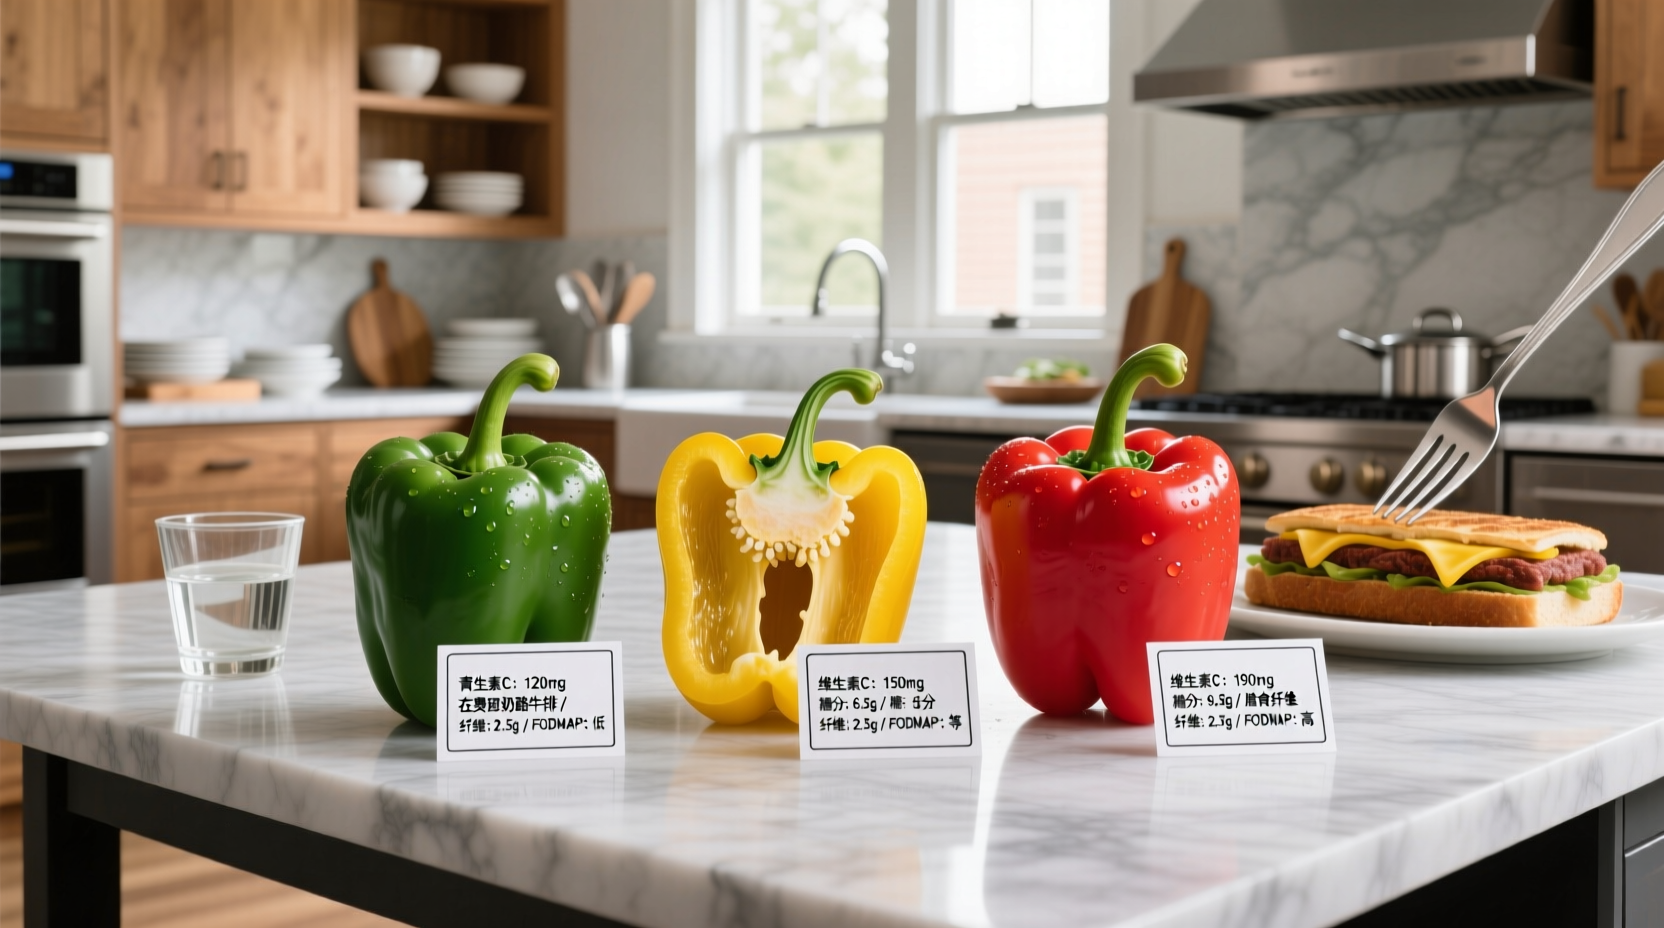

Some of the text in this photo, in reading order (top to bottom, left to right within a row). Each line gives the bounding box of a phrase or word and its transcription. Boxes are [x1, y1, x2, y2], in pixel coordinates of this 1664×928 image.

[883, 676, 925, 693] 150mg
[852, 697, 877, 713] 6.5g
[880, 696, 886, 711] /
[1235, 693, 1241, 709] /
[493, 718, 519, 735] 2.5g
[523, 718, 529, 733] /
[531, 717, 588, 731] FODMAP:
[880, 717, 886, 731] /
[1236, 714, 1241, 729] /
